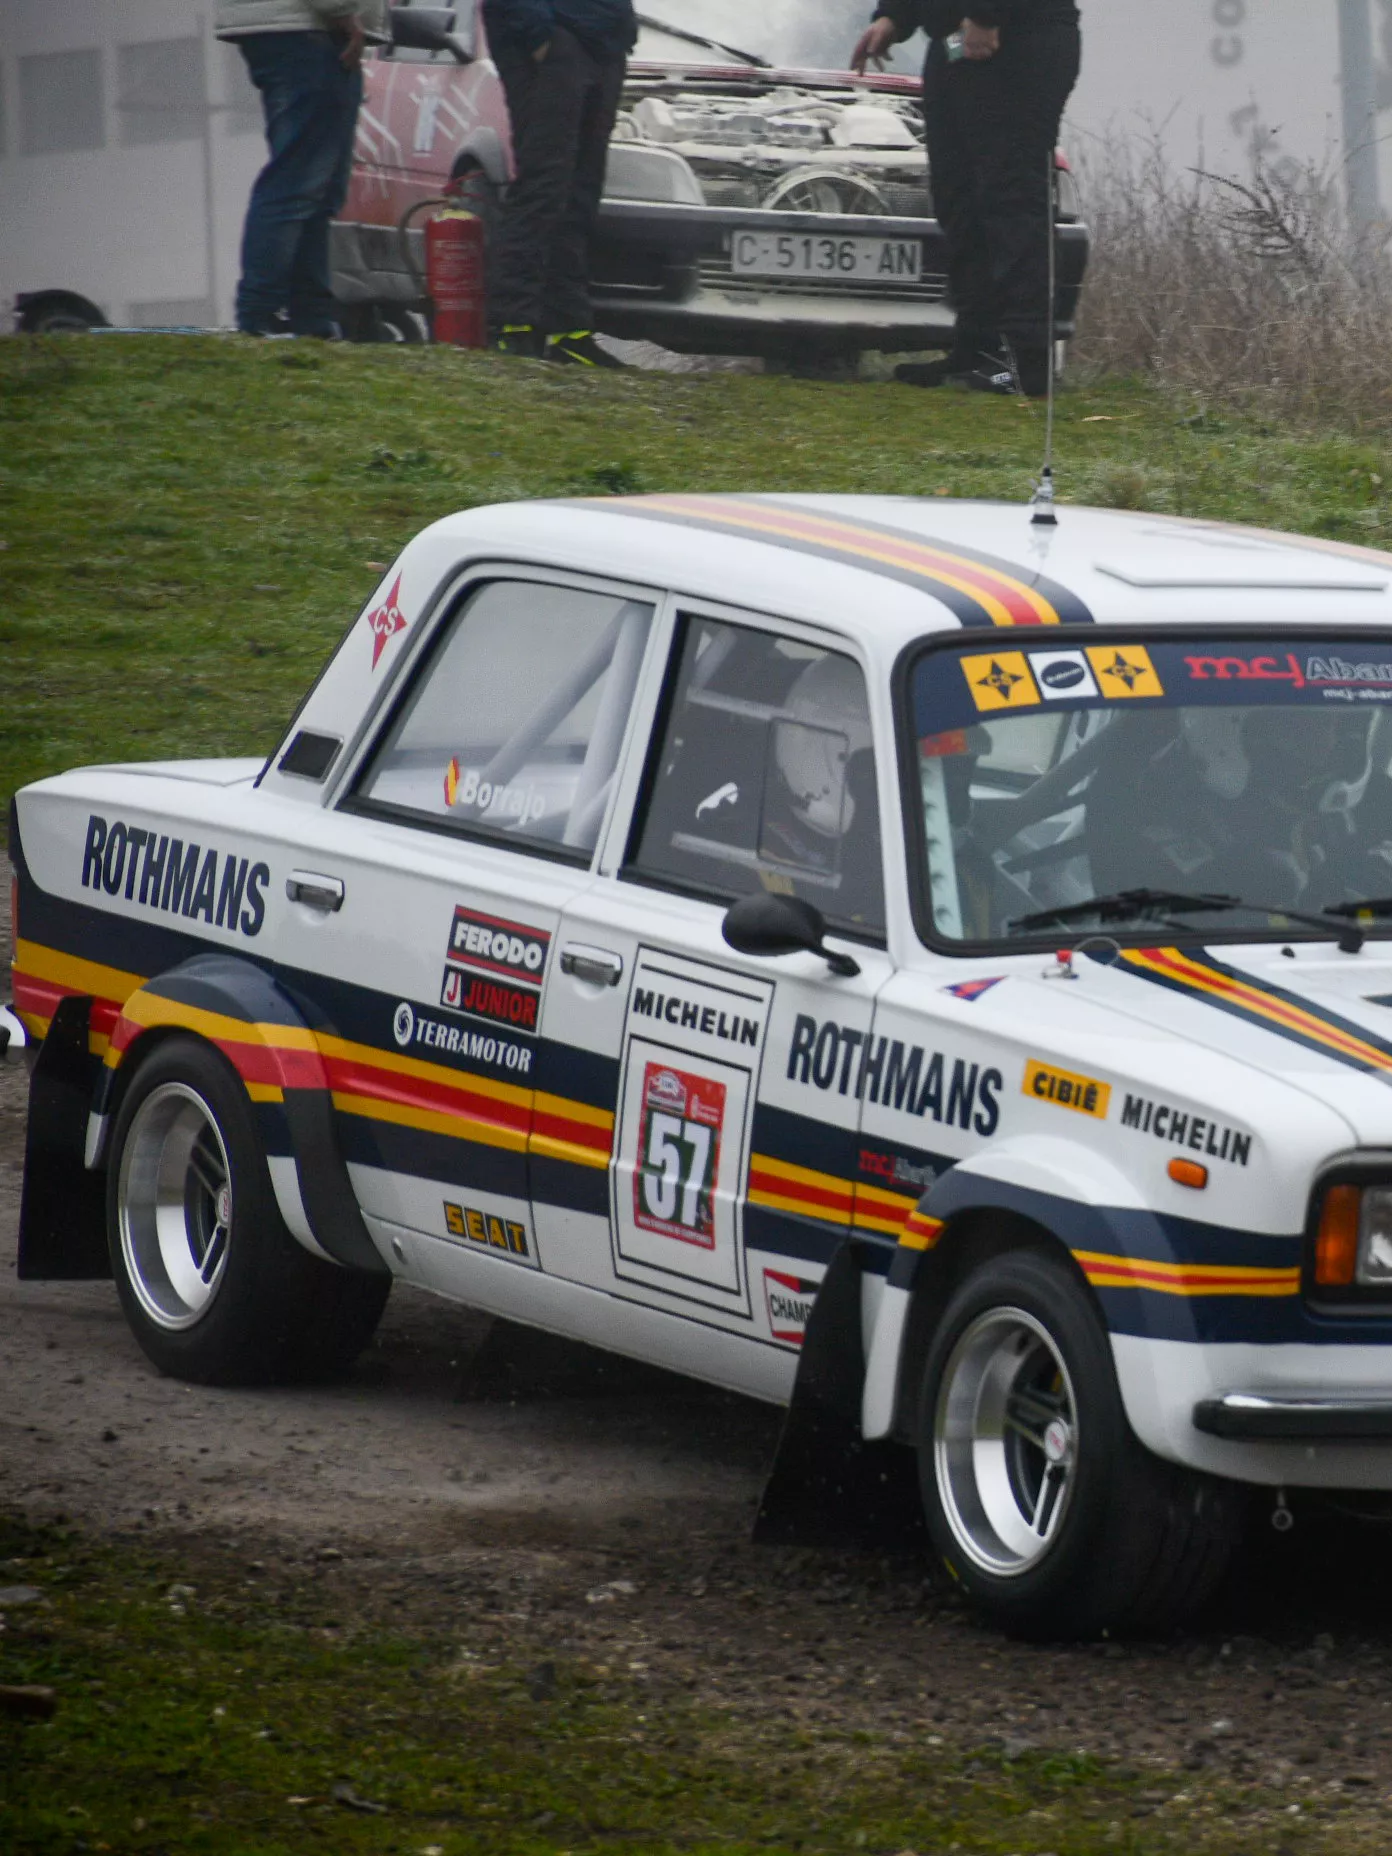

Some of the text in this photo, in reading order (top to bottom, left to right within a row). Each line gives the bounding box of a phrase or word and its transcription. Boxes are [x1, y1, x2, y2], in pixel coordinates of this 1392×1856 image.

[461, 770, 547, 826] Borrajo
[82, 815, 270, 937] ROTHMANS
[454, 920, 544, 970] FERODO
[464, 980, 538, 1026] JUNIOR
[632, 986, 760, 1047] MICHELIN
[416, 1017, 533, 1074] TERRAMOTOR
[787, 1013, 1003, 1138] ROTHMANS
[1119, 1092, 1254, 1167] MICHELIN
[643, 1112, 713, 1228] 57
[446, 1203, 526, 1254] SEAT
